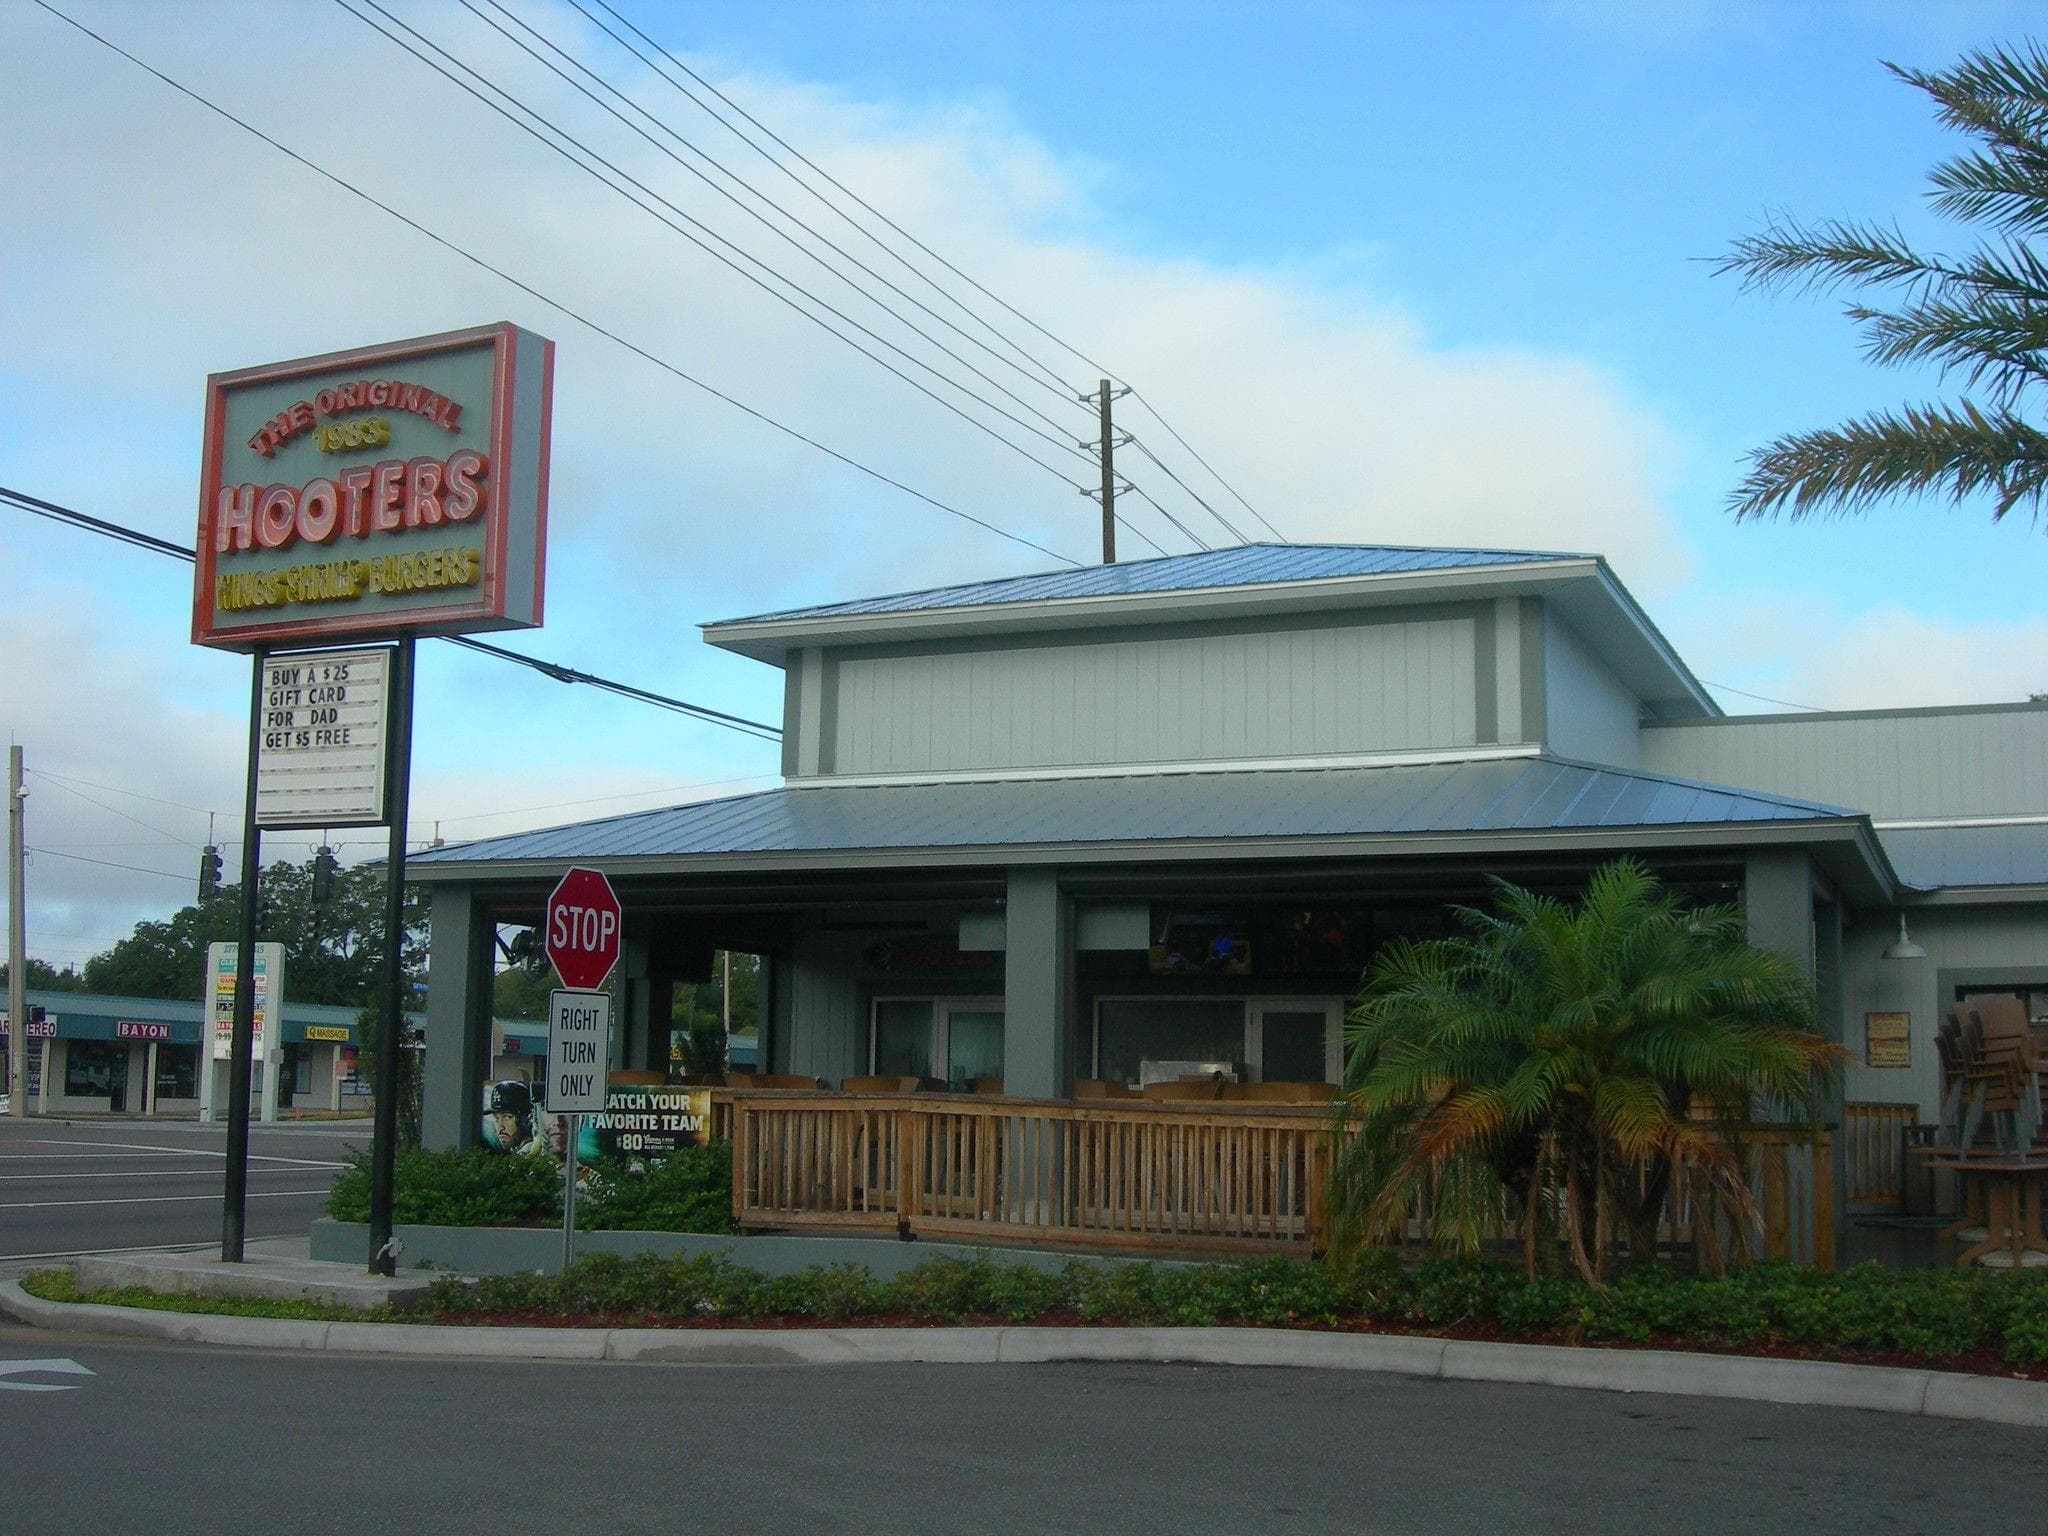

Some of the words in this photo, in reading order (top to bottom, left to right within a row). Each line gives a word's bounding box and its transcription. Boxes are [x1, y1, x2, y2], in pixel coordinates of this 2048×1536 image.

[248, 400, 317, 459] THE
[313, 379, 464, 434] ORIGINAL
[312, 415, 391, 455] 1983
[215, 449, 490, 554] HOOTERS
[215, 567, 288, 611] WINGS
[287, 559, 369, 603] SHRIMP
[368, 546, 481, 594] BURGERS
[271, 668, 300, 686] BUY
[307, 667, 316, 683] A
[269, 689, 301, 706] GIFT
[308, 686, 345, 704] CARD
[267, 711, 294, 727] FOR
[310, 708, 338, 725] DAD
[266, 731, 292, 748] GET
[295, 730, 310, 747] $5
[315, 729, 350, 746] FREE
[552, 904, 616, 952] STOP
[560, 1007, 599, 1031] RIGHT
[28, 1022, 56, 1036] EREO
[122, 1023, 168, 1038] BAYON
[316, 1028, 348, 1039] MASSAGE
[562, 1041, 596, 1064] TURN
[560, 1074, 594, 1097] ONLY
[606, 1093, 646, 1110] ATCH
[649, 1094, 691, 1111] YOUR
[588, 1113, 659, 1130] FAVORITE
[661, 1114, 704, 1132] TEAM
[622, 1133, 643, 1151] 80
